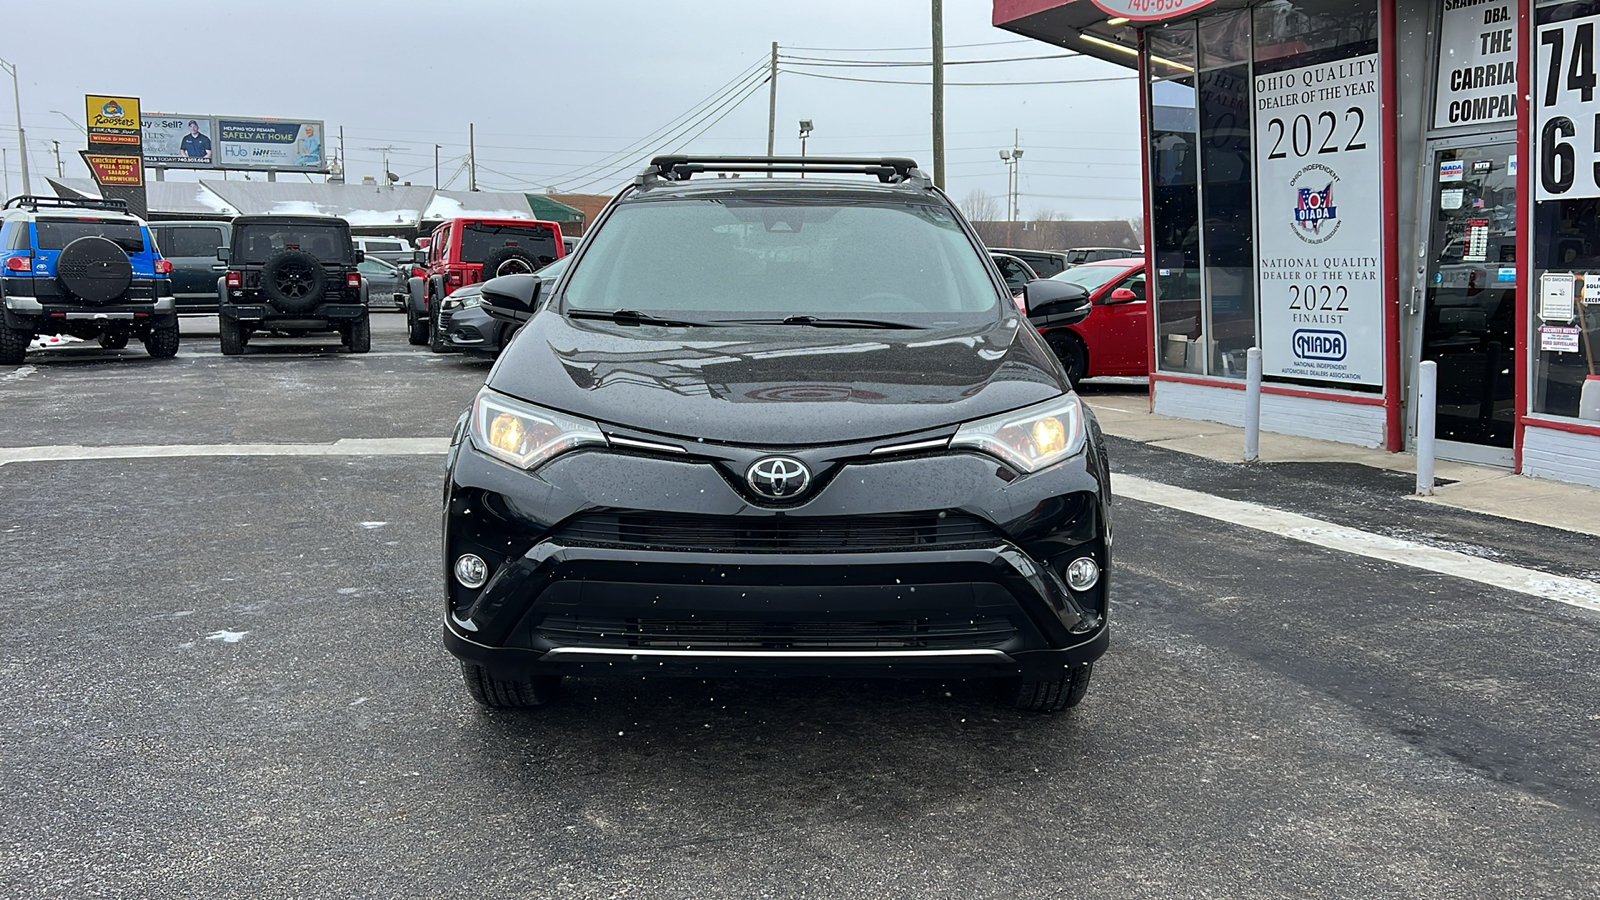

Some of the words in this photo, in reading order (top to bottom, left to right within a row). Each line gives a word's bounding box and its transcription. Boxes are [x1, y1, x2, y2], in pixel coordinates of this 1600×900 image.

[1484, 6, 1511, 24] DBA.
[1480, 29, 1512, 55] THE
[1256, 73, 1295, 93] OHIO
[1302, 58, 1377, 87] QUALITY
[1451, 61, 1518, 92] CARRIA
[1258, 93, 1299, 110] DEALER
[1301, 91, 1316, 103] OF
[1318, 86, 1341, 101] THE
[1344, 80, 1375, 97] YEAR
[93, 114, 135, 127] Roosters
[1267, 106, 1367, 160] 2022
[1541, 113, 1600, 194] 6
[1290, 170, 1302, 187] OHIO
[1302, 163, 1341, 183] INDEPENDENT
[1300, 208, 1330, 220] OIADA
[1261, 258, 1319, 268] NATIONAL
[1323, 257, 1378, 269] QUALITY
[1263, 271, 1301, 280] DEALER
[1305, 272, 1318, 280] OF
[1323, 272, 1343, 280] THE
[1348, 271, 1376, 280] YEAR
[1288, 285, 1349, 312] 2022
[1292, 314, 1344, 324] FINALIST
[1297, 336, 1341, 357] NIADA
[1282, 368, 1308, 376] AUTOMOBILE
[1330, 372, 1361, 380] ASSOCIATION
[1294, 361, 1316, 369] NATIONAL
[1316, 362, 1348, 370] INDEPENDENT
